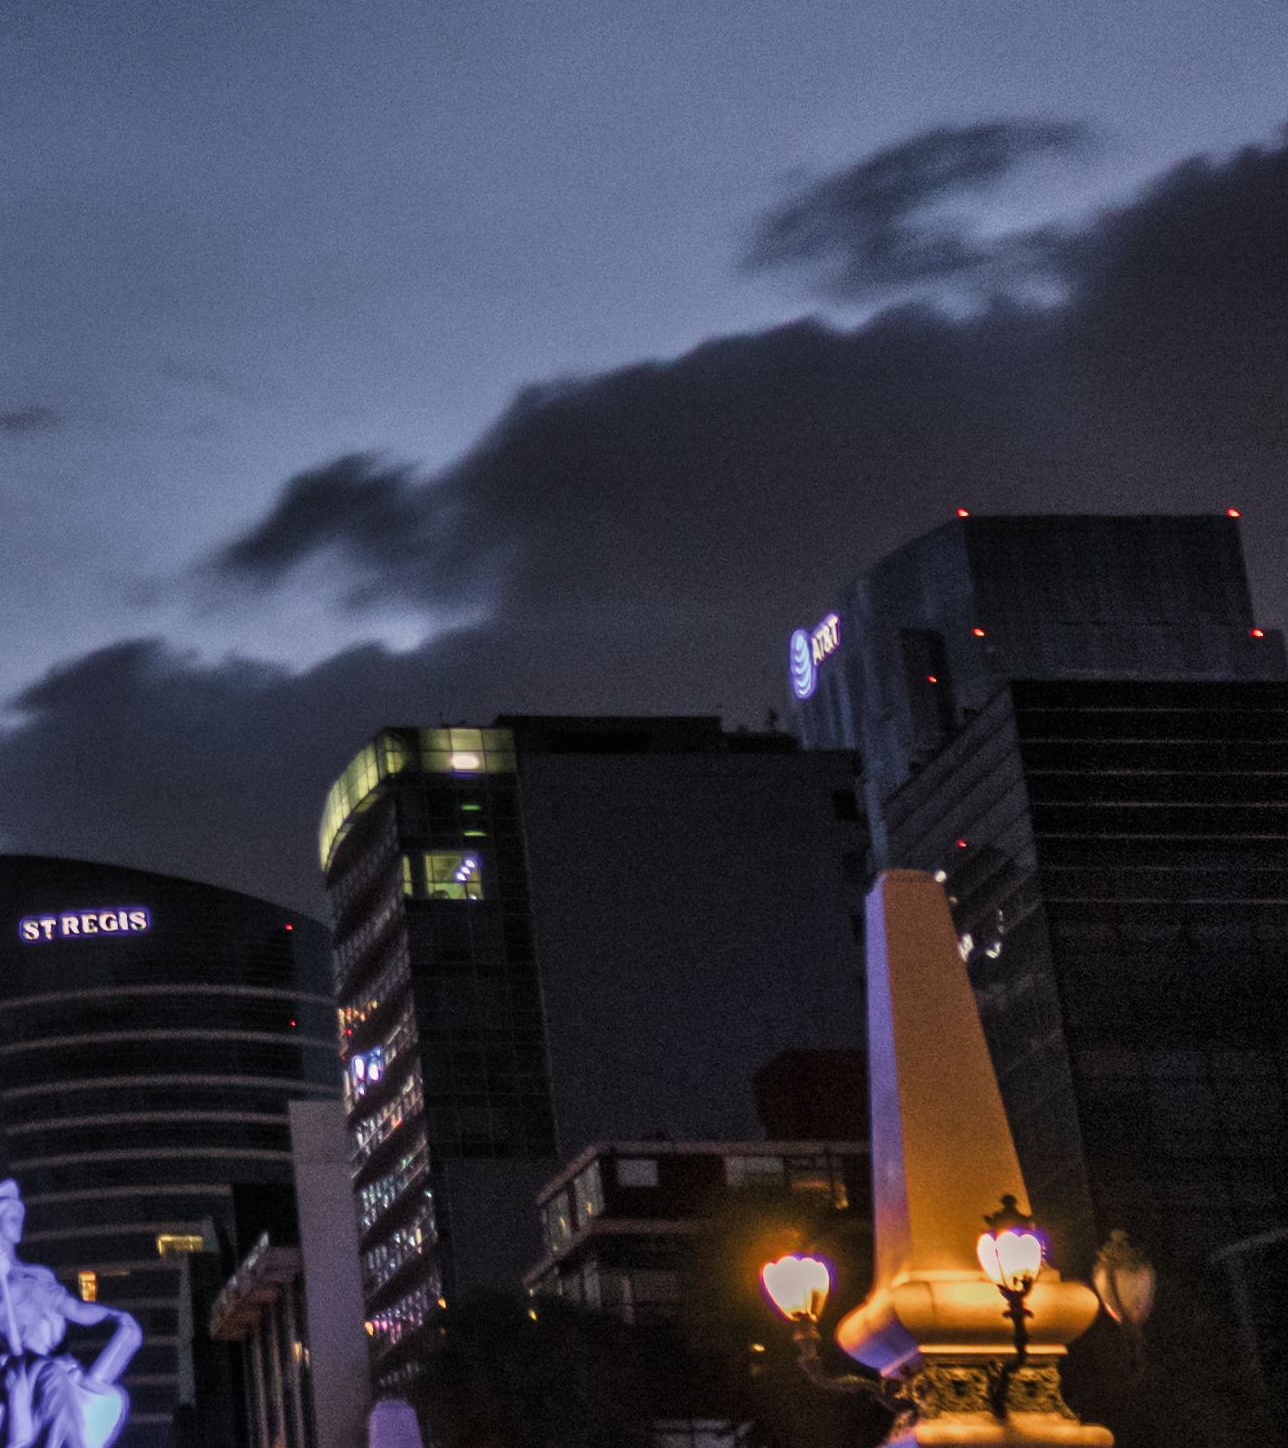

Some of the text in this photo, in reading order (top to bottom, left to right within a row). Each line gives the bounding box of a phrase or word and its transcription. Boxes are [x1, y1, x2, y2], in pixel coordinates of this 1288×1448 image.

[811, 614, 838, 665] AT&T
[22, 910, 148, 941] ST REGIS
